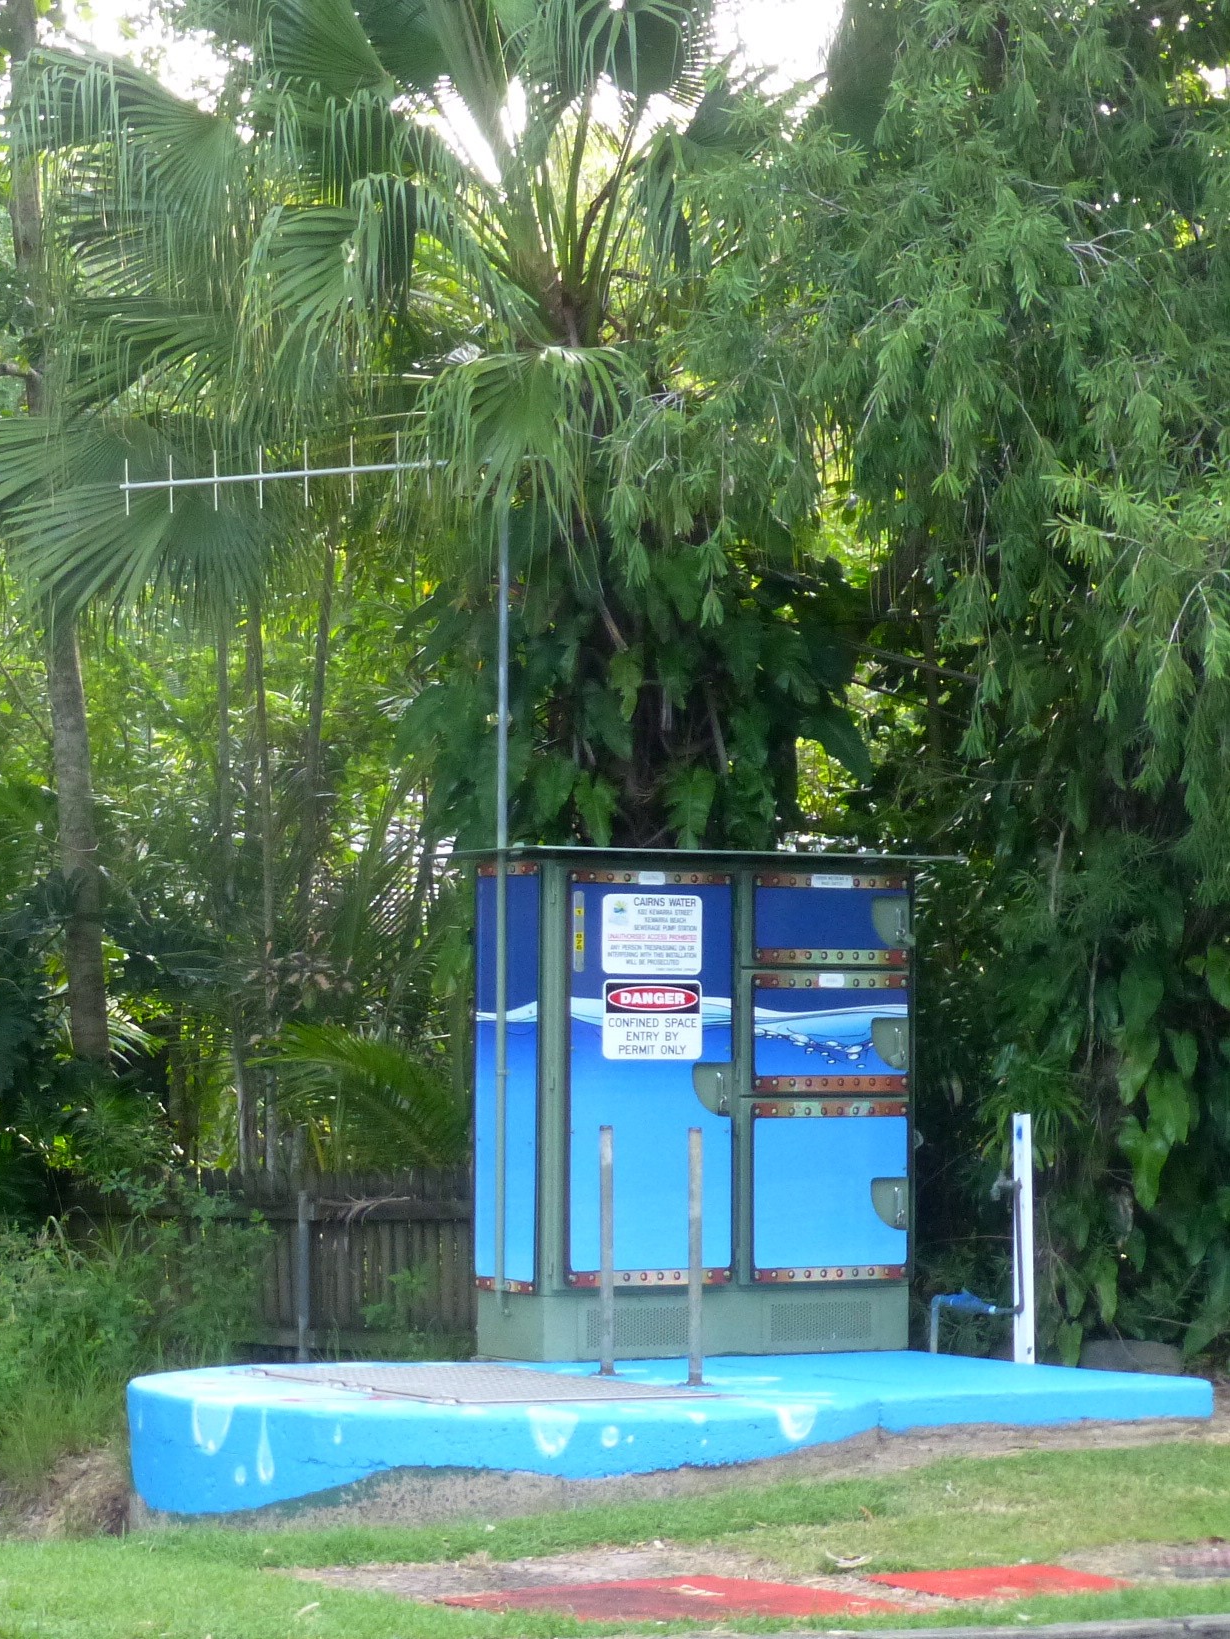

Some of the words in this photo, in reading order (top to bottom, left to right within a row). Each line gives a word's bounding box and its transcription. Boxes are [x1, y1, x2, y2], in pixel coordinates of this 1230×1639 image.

[634, 897, 665, 906] CAIRNS
[669, 898, 696, 907] WATER
[620, 992, 686, 1004] DANGER
[609, 1018, 659, 1028] CONFINED
[665, 1018, 696, 1028] SPACE
[626, 1032, 659, 1041] ENTRY
[665, 1032, 678, 1041] BY
[619, 1045, 654, 1054] PERMIT
[661, 1045, 686, 1054] ONLY
